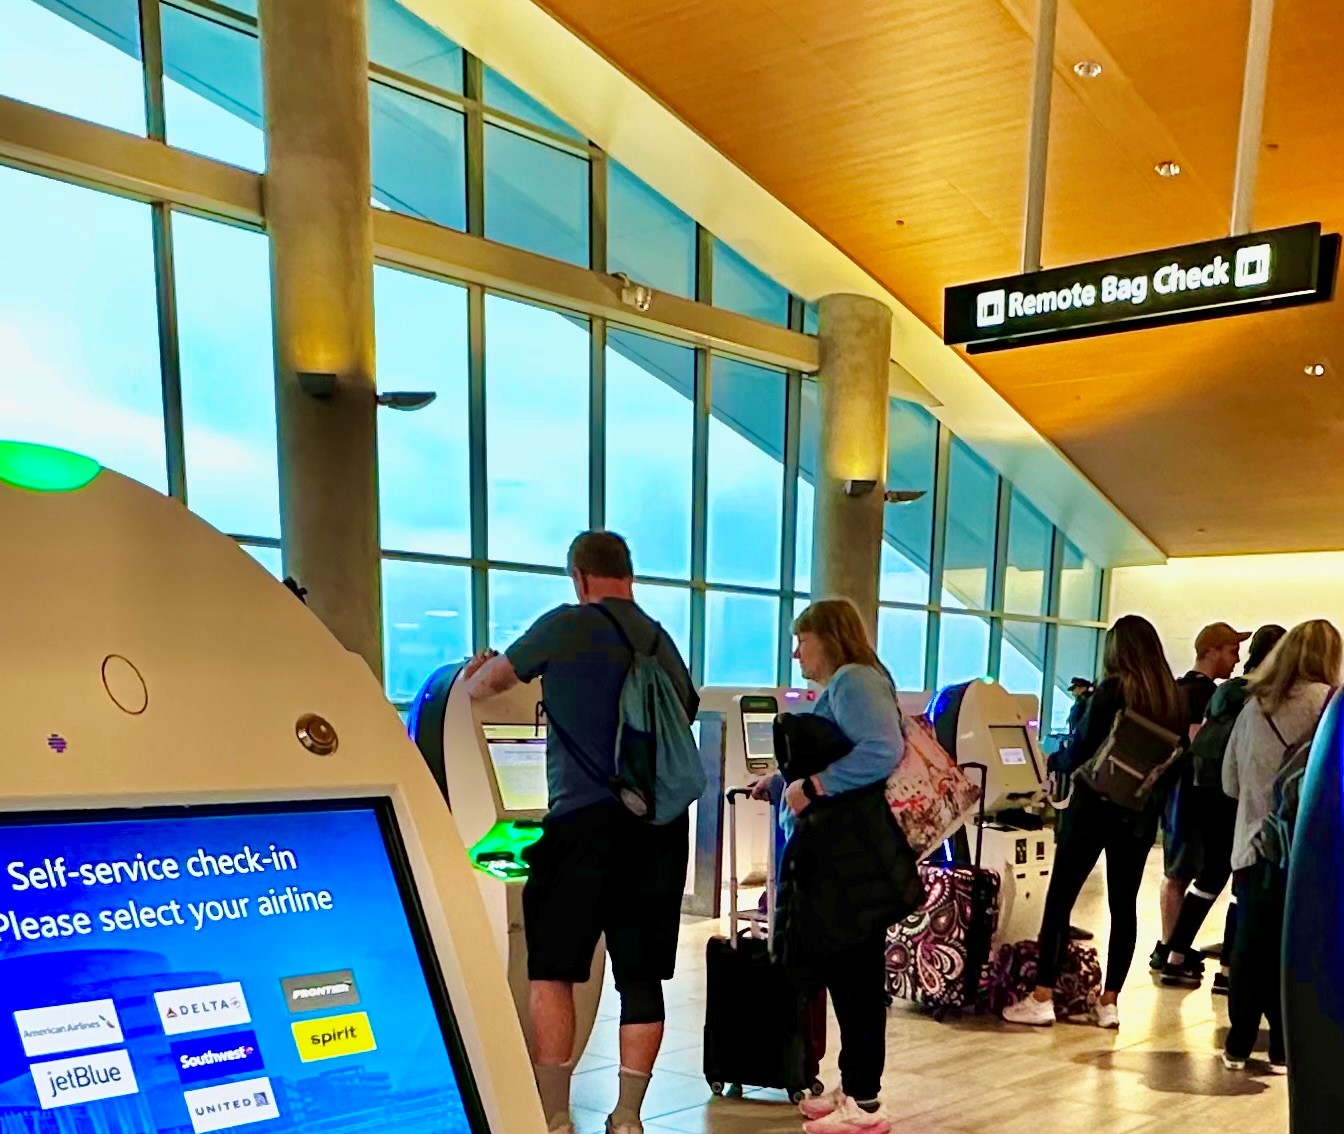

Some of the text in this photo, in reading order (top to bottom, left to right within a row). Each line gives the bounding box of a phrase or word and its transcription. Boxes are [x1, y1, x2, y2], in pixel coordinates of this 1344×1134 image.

[1008, 255, 1230, 318] Remote Bag Check
[7, 845, 298, 892] Self-service check-in
[99, 899, 185, 932] select
[188, 897, 250, 931] your
[258, 886, 333, 917] airline
[292, 983, 351, 1000] FRONTIER
[179, 1000, 230, 1016] DELTA
[23, 1020, 102, 1038] American Airlines
[310, 1026, 357, 1047] spirit
[180, 1047, 247, 1069] Southwest
[47, 1064, 122, 1097] jetBlue
[195, 1097, 252, 1117] UNITED
